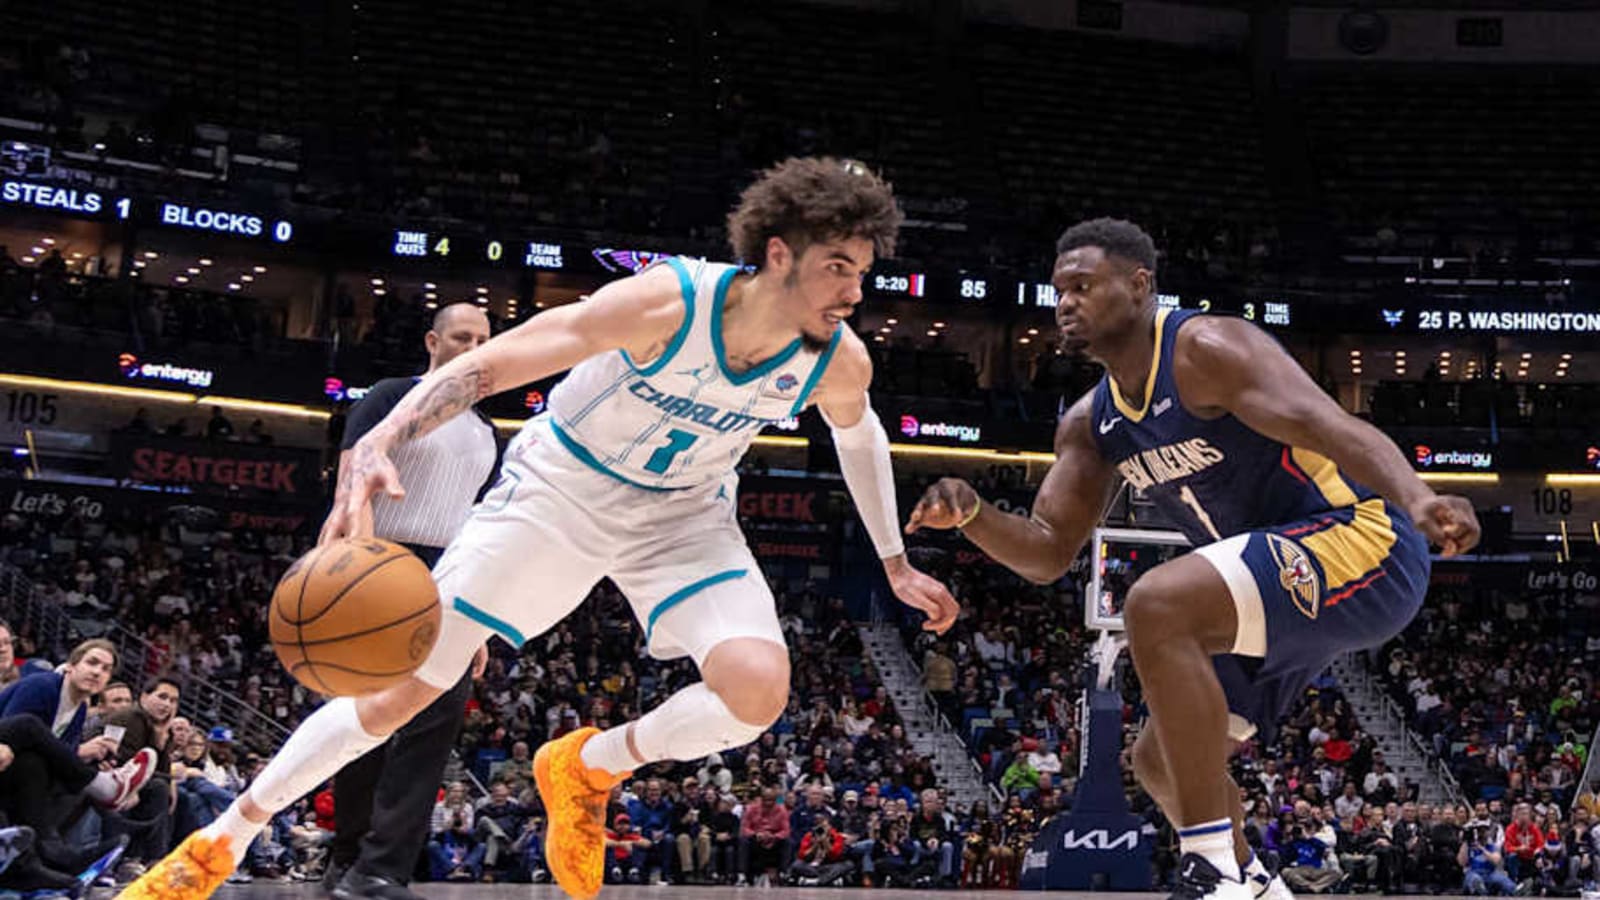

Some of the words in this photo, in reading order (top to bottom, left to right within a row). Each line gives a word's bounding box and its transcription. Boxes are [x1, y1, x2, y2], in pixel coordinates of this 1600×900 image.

[2, 181, 101, 212] STEALS
[116, 199, 130, 218] 1
[163, 203, 262, 235] BLOCKS
[275, 222, 292, 241] 0
[397, 231, 427, 244] TIME
[434, 238, 450, 255] 4
[394, 242, 427, 256] OUTS
[487, 241, 502, 260] 0
[528, 243, 562, 256] TEAM
[526, 254, 563, 268] FOULS
[875, 275, 908, 291] 9:20
[961, 279, 986, 298] 85
[1156, 294, 1180, 307] EAM
[1264, 302, 1290, 314] TIME
[1243, 303, 1255, 321] 3
[1264, 313, 1290, 325] OUTS
[1418, 311, 1443, 329] 25
[1448, 312, 1465, 329] P.
[1468, 312, 1600, 331] WASHINGTON
[141, 363, 213, 387] entergy
[7, 392, 58, 425] 105
[629, 380, 776, 433] CHARLOTT
[920, 422, 980, 442] entergy
[643, 428, 699, 475] 1
[1434, 451, 1492, 468] entergy
[131, 448, 298, 493] SEATGEEK
[11, 490, 66, 515] Let's
[1533, 488, 1572, 515] 108
[1180, 485, 1222, 540] 1
[1572, 570, 1597, 590] Go
[1064, 829, 1138, 850] KIA
